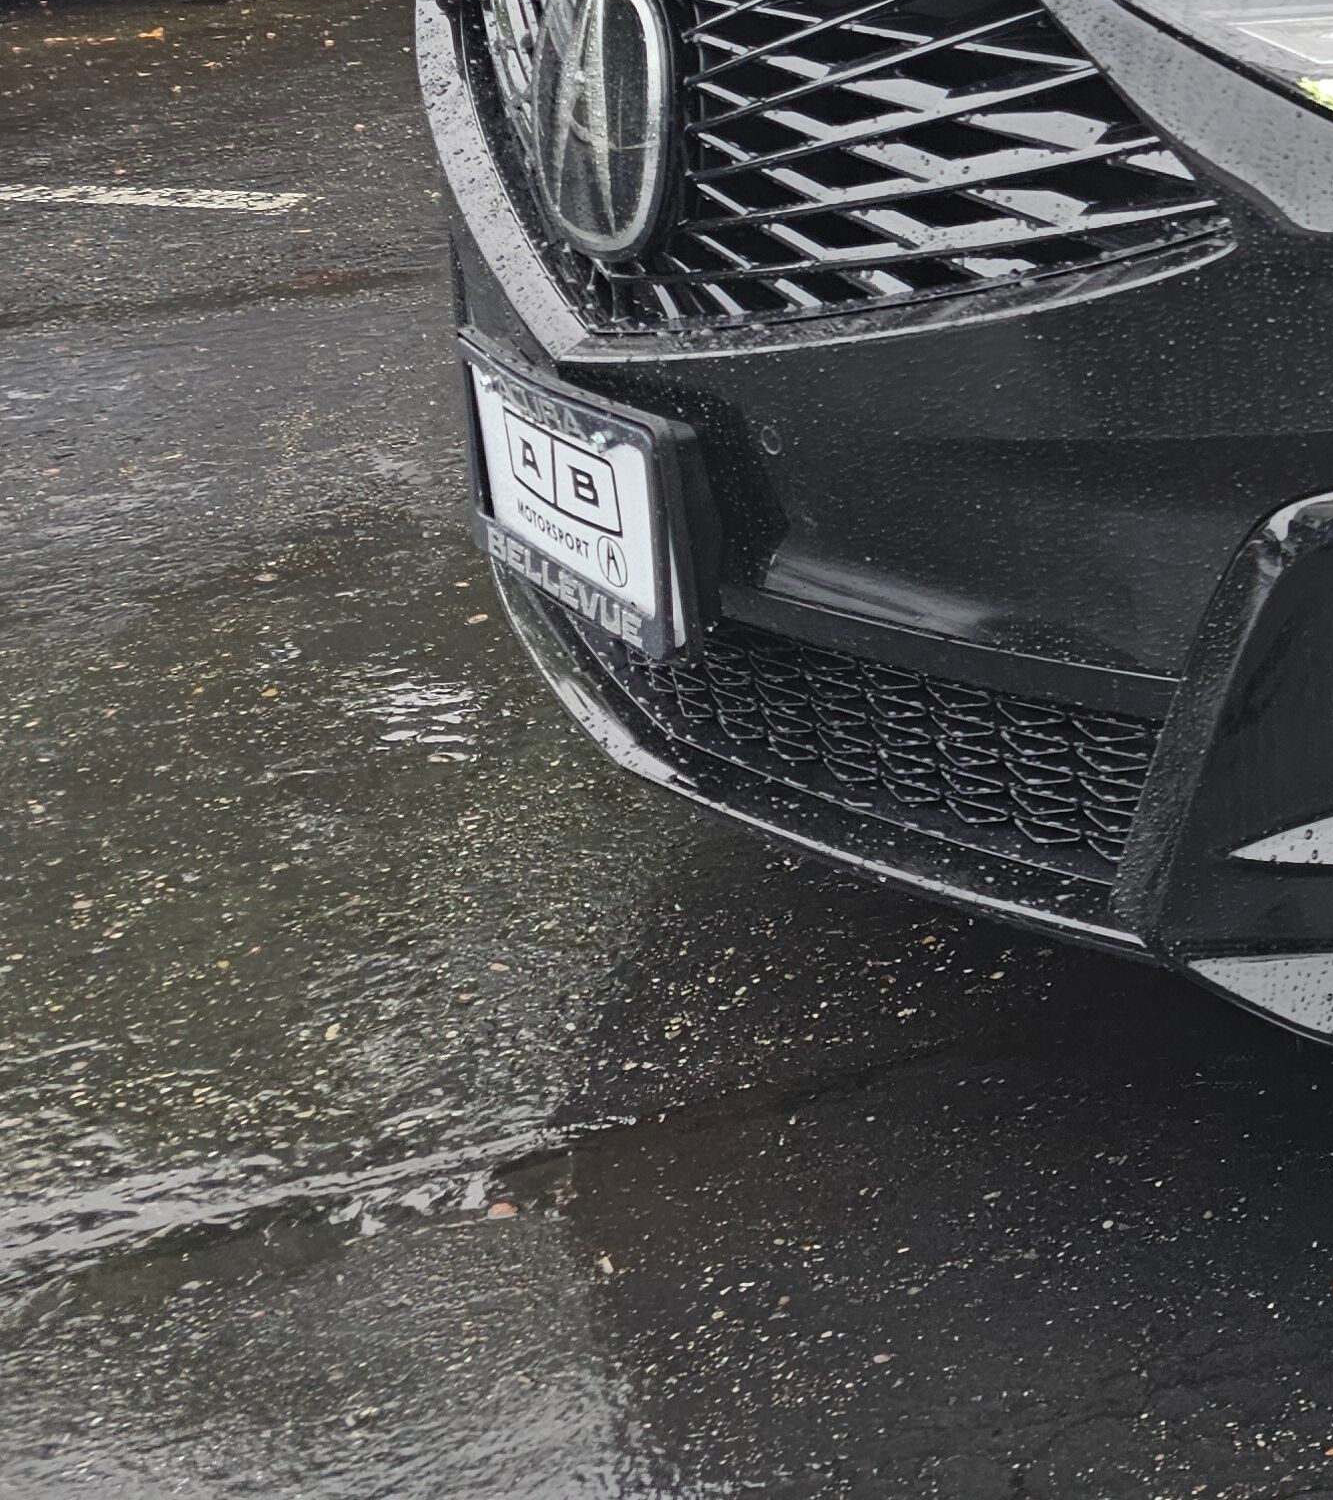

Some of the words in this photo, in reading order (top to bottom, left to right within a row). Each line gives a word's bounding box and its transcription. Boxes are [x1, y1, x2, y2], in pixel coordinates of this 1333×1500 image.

[500, 377, 588, 442] ACURA
[519, 436, 542, 480] A
[567, 464, 600, 508] B
[517, 498, 590, 560] MOTORSPORT
[487, 524, 644, 650] BELLEVUE
